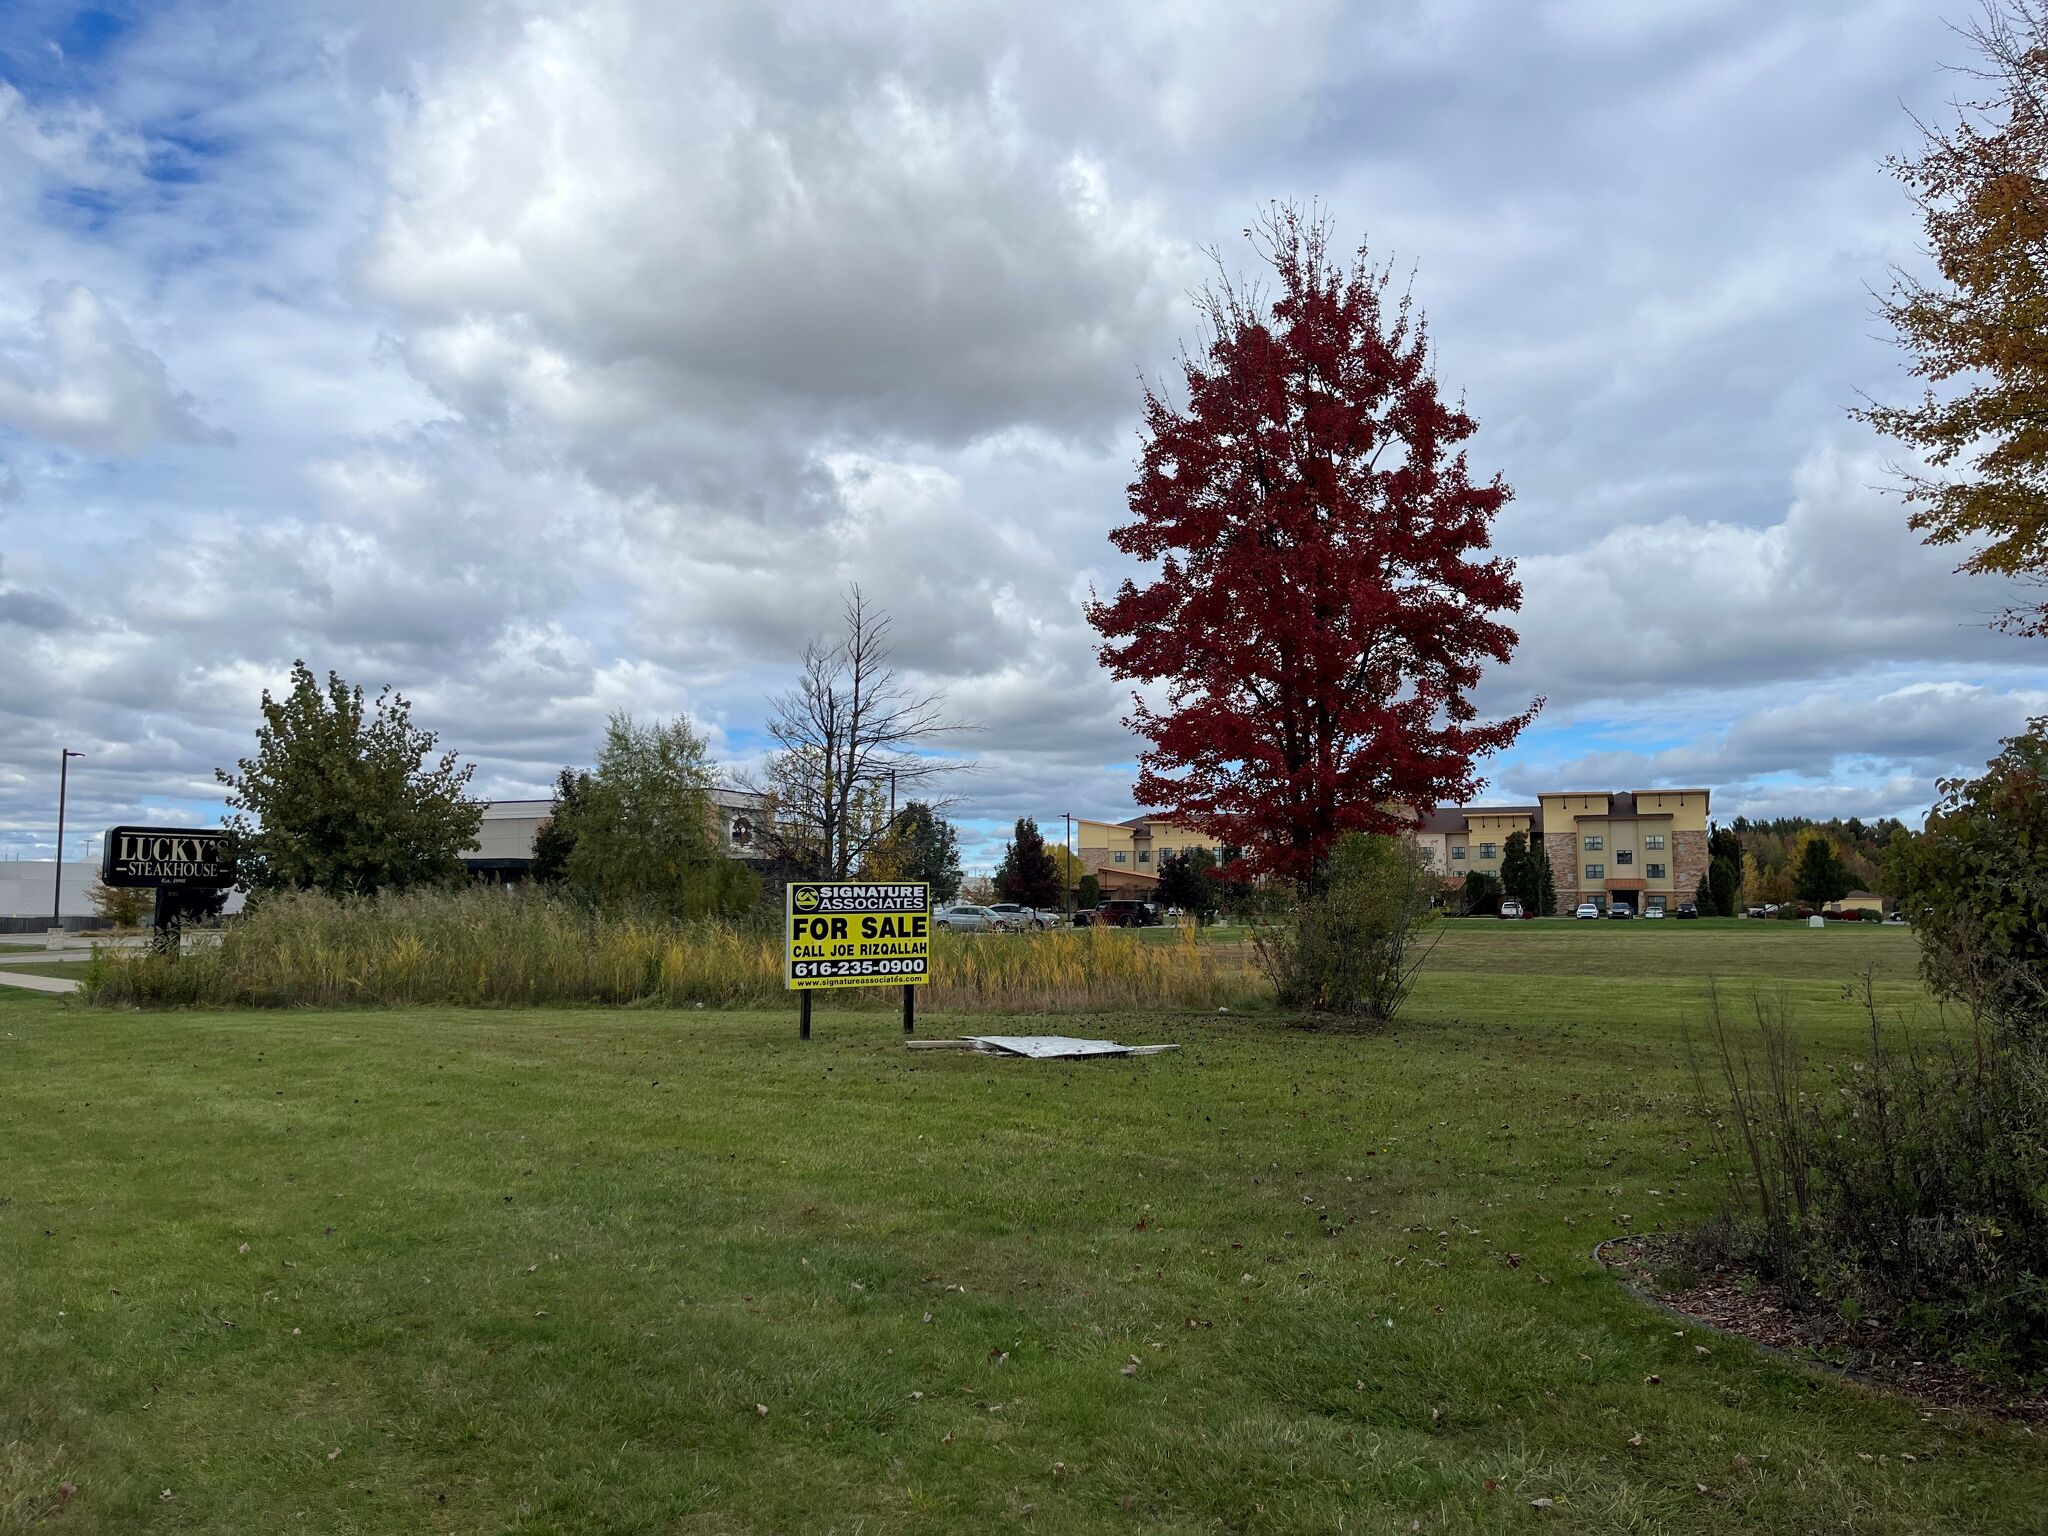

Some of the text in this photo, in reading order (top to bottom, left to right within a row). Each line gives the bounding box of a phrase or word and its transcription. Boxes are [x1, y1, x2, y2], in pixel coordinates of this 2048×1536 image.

[128, 861, 218, 877] STEAKHOUSE
[820, 886, 924, 898] SIGNATURE
[819, 897, 924, 910] ASSOCIATES
[793, 916, 927, 940] FOR SALE
[793, 942, 927, 958] CALL JOE RIZQALLAH
[795, 959, 925, 976] 616-235-0900
[797, 976, 922, 987] www.signatureassociates.com
